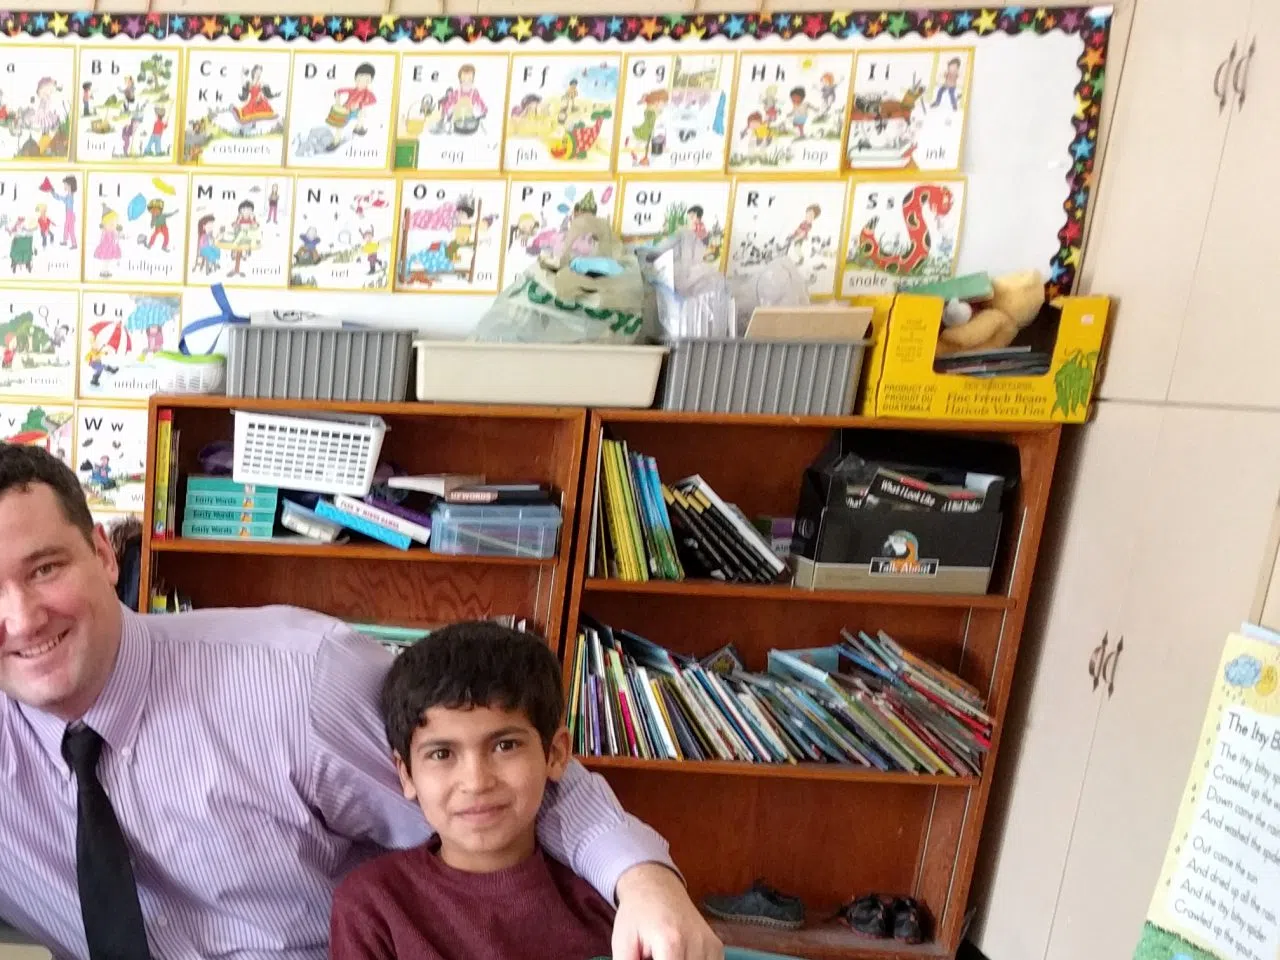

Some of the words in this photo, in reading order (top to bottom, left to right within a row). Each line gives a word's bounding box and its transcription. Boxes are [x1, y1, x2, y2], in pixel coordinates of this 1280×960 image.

[7, 62, 16, 73] a
[91, 59, 103, 76] B
[111, 60, 120, 76] b
[199, 60, 212, 77] C
[220, 65, 227, 77] c
[304, 62, 318, 79] D
[326, 64, 337, 79] d
[412, 65, 423, 82] E
[431, 69, 439, 81] e
[633, 60, 647, 78] G
[656, 65, 666, 81] g
[751, 63, 766, 82] H
[775, 64, 785, 81] h
[868, 63, 877, 80] I
[885, 64, 890, 80] i
[523, 65, 533, 82] F
[539, 66, 550, 88] f
[199, 87, 208, 102] K
[215, 88, 223, 103] k
[212, 142, 271, 156] castanets
[345, 143, 379, 158] drum
[441, 148, 464, 165] egg
[516, 146, 539, 165] fish
[670, 147, 713, 166] gurgle
[802, 148, 829, 166] hop
[925, 146, 945, 160] ink
[12, 181, 18, 202] j
[98, 182, 108, 198] L
[197, 184, 213, 201] M
[221, 187, 236, 201] m
[307, 188, 321, 204] N
[330, 193, 339, 204] n
[413, 184, 427, 200] O
[436, 188, 446, 200] o
[522, 186, 534, 201] P
[542, 190, 552, 207] p
[635, 190, 662, 206] QU
[747, 191, 759, 207] R
[768, 195, 776, 207] r
[867, 192, 878, 209] S
[886, 197, 895, 209] s
[633, 211, 652, 226] qu
[128, 259, 174, 276] lollipop
[252, 264, 281, 277] meal
[331, 268, 349, 280] net
[477, 271, 493, 281] on
[848, 273, 888, 288] snake
[93, 302, 107, 317] U
[115, 308, 123, 317] u
[947, 392, 969, 403] Fine
[973, 392, 1011, 404] French
[1014, 393, 1048, 404] Beans
[882, 403, 932, 413] GUATEMALA
[944, 403, 990, 415] Haricots
[994, 404, 1019, 416] Verts
[1023, 404, 1046, 416] Fins
[8, 417, 16, 428] v
[84, 416, 103, 432] W
[111, 422, 125, 432] w
[881, 479, 900, 496] What
[904, 487, 921, 502] Look
[920, 491, 936, 507] Like
[878, 562, 897, 573] Talk
[900, 562, 932, 574] About
[1228, 711, 1248, 736] The
[1251, 721, 1269, 752] Itsy
[1221, 741, 1237, 761] The
[1214, 764, 1252, 793] Crawled
[1262, 788, 1272, 807] the
[1207, 784, 1233, 808] Down
[1235, 803, 1253, 823] came
[1255, 811, 1266, 828] the
[1200, 808, 1224, 829] And
[1225, 823, 1251, 846] washed
[1251, 836, 1261, 853] the
[1193, 835, 1212, 855] Out
[1214, 850, 1234, 868] came
[1235, 860, 1246, 876] the
[1186, 857, 1210, 878] And
[1210, 868, 1232, 892] dried
[1251, 895, 1261, 914] the
[1180, 878, 1204, 900] And
[1204, 889, 1216, 907] the
[1247, 921, 1267, 943] spider
[1173, 898, 1214, 930] Crawled
[1224, 927, 1234, 944] the
